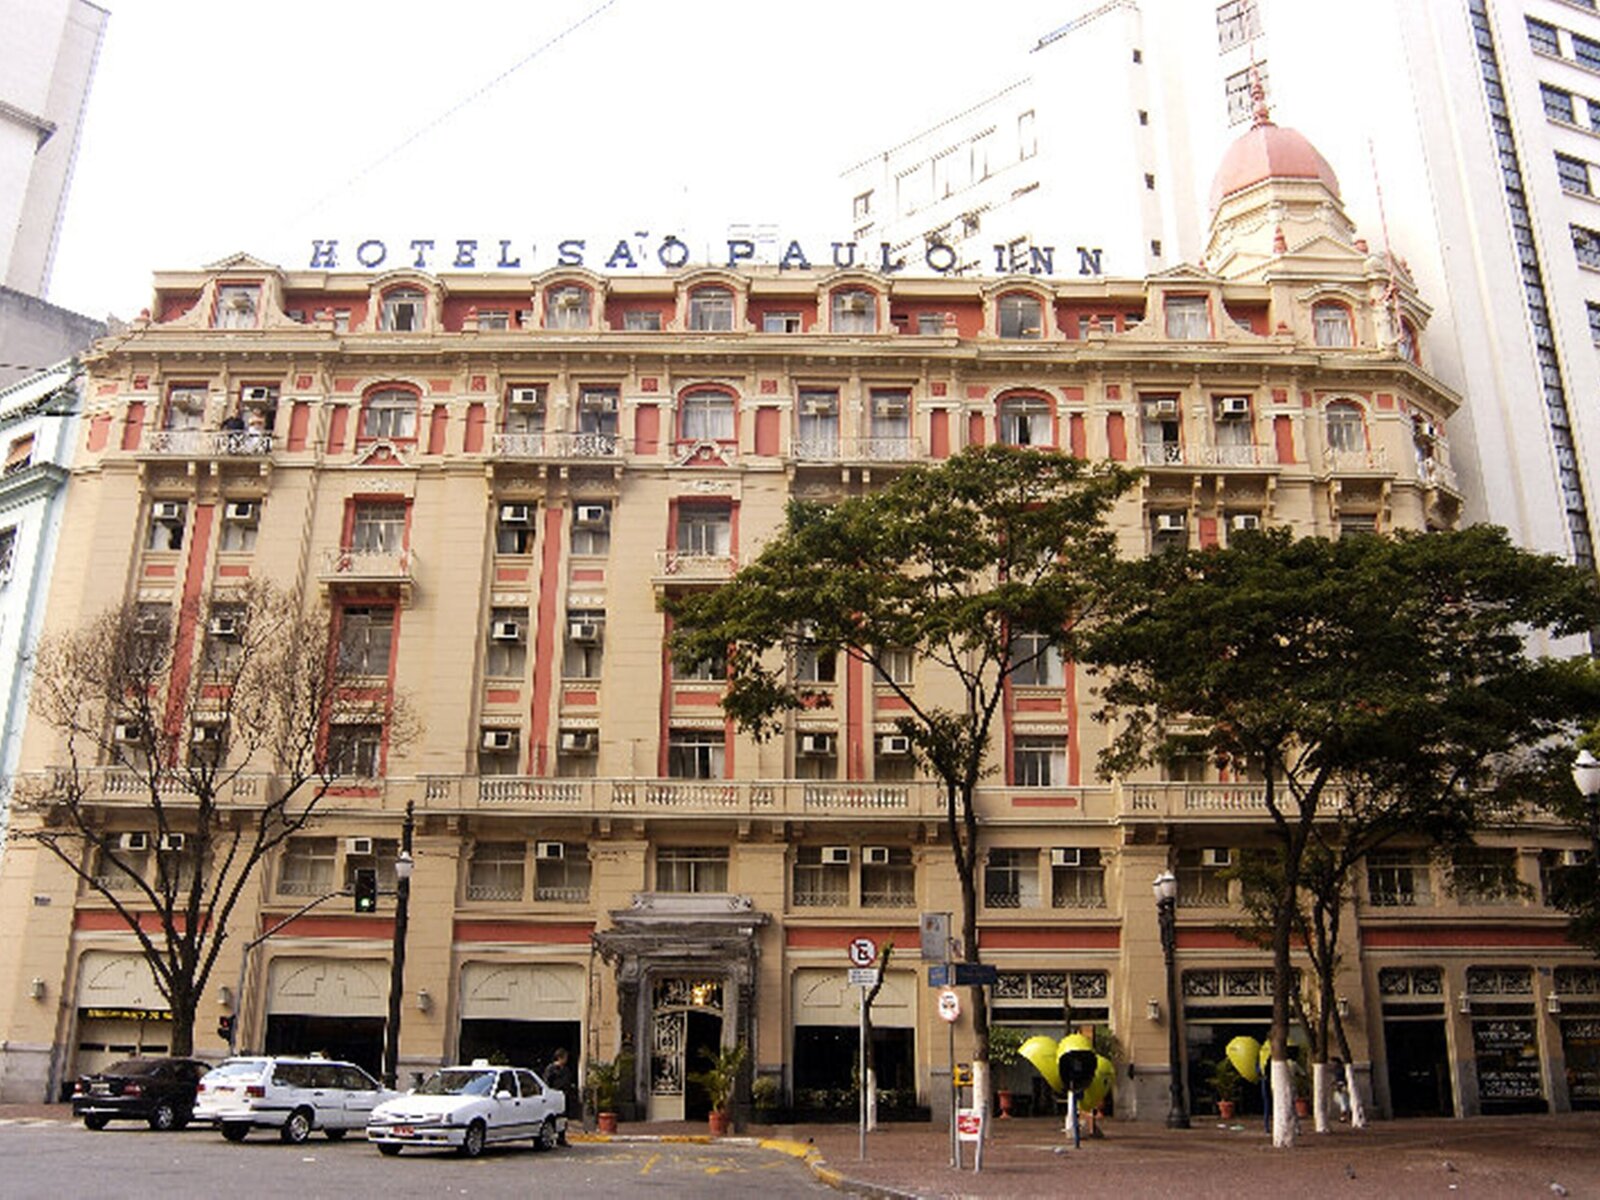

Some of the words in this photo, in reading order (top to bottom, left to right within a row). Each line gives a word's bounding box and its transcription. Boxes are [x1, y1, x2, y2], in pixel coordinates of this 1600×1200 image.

[310, 240, 521, 268] HOTEL
[726, 240, 957, 273] PAULO
[993, 243, 1103, 276] INN
[857, 942, 869, 961] E
